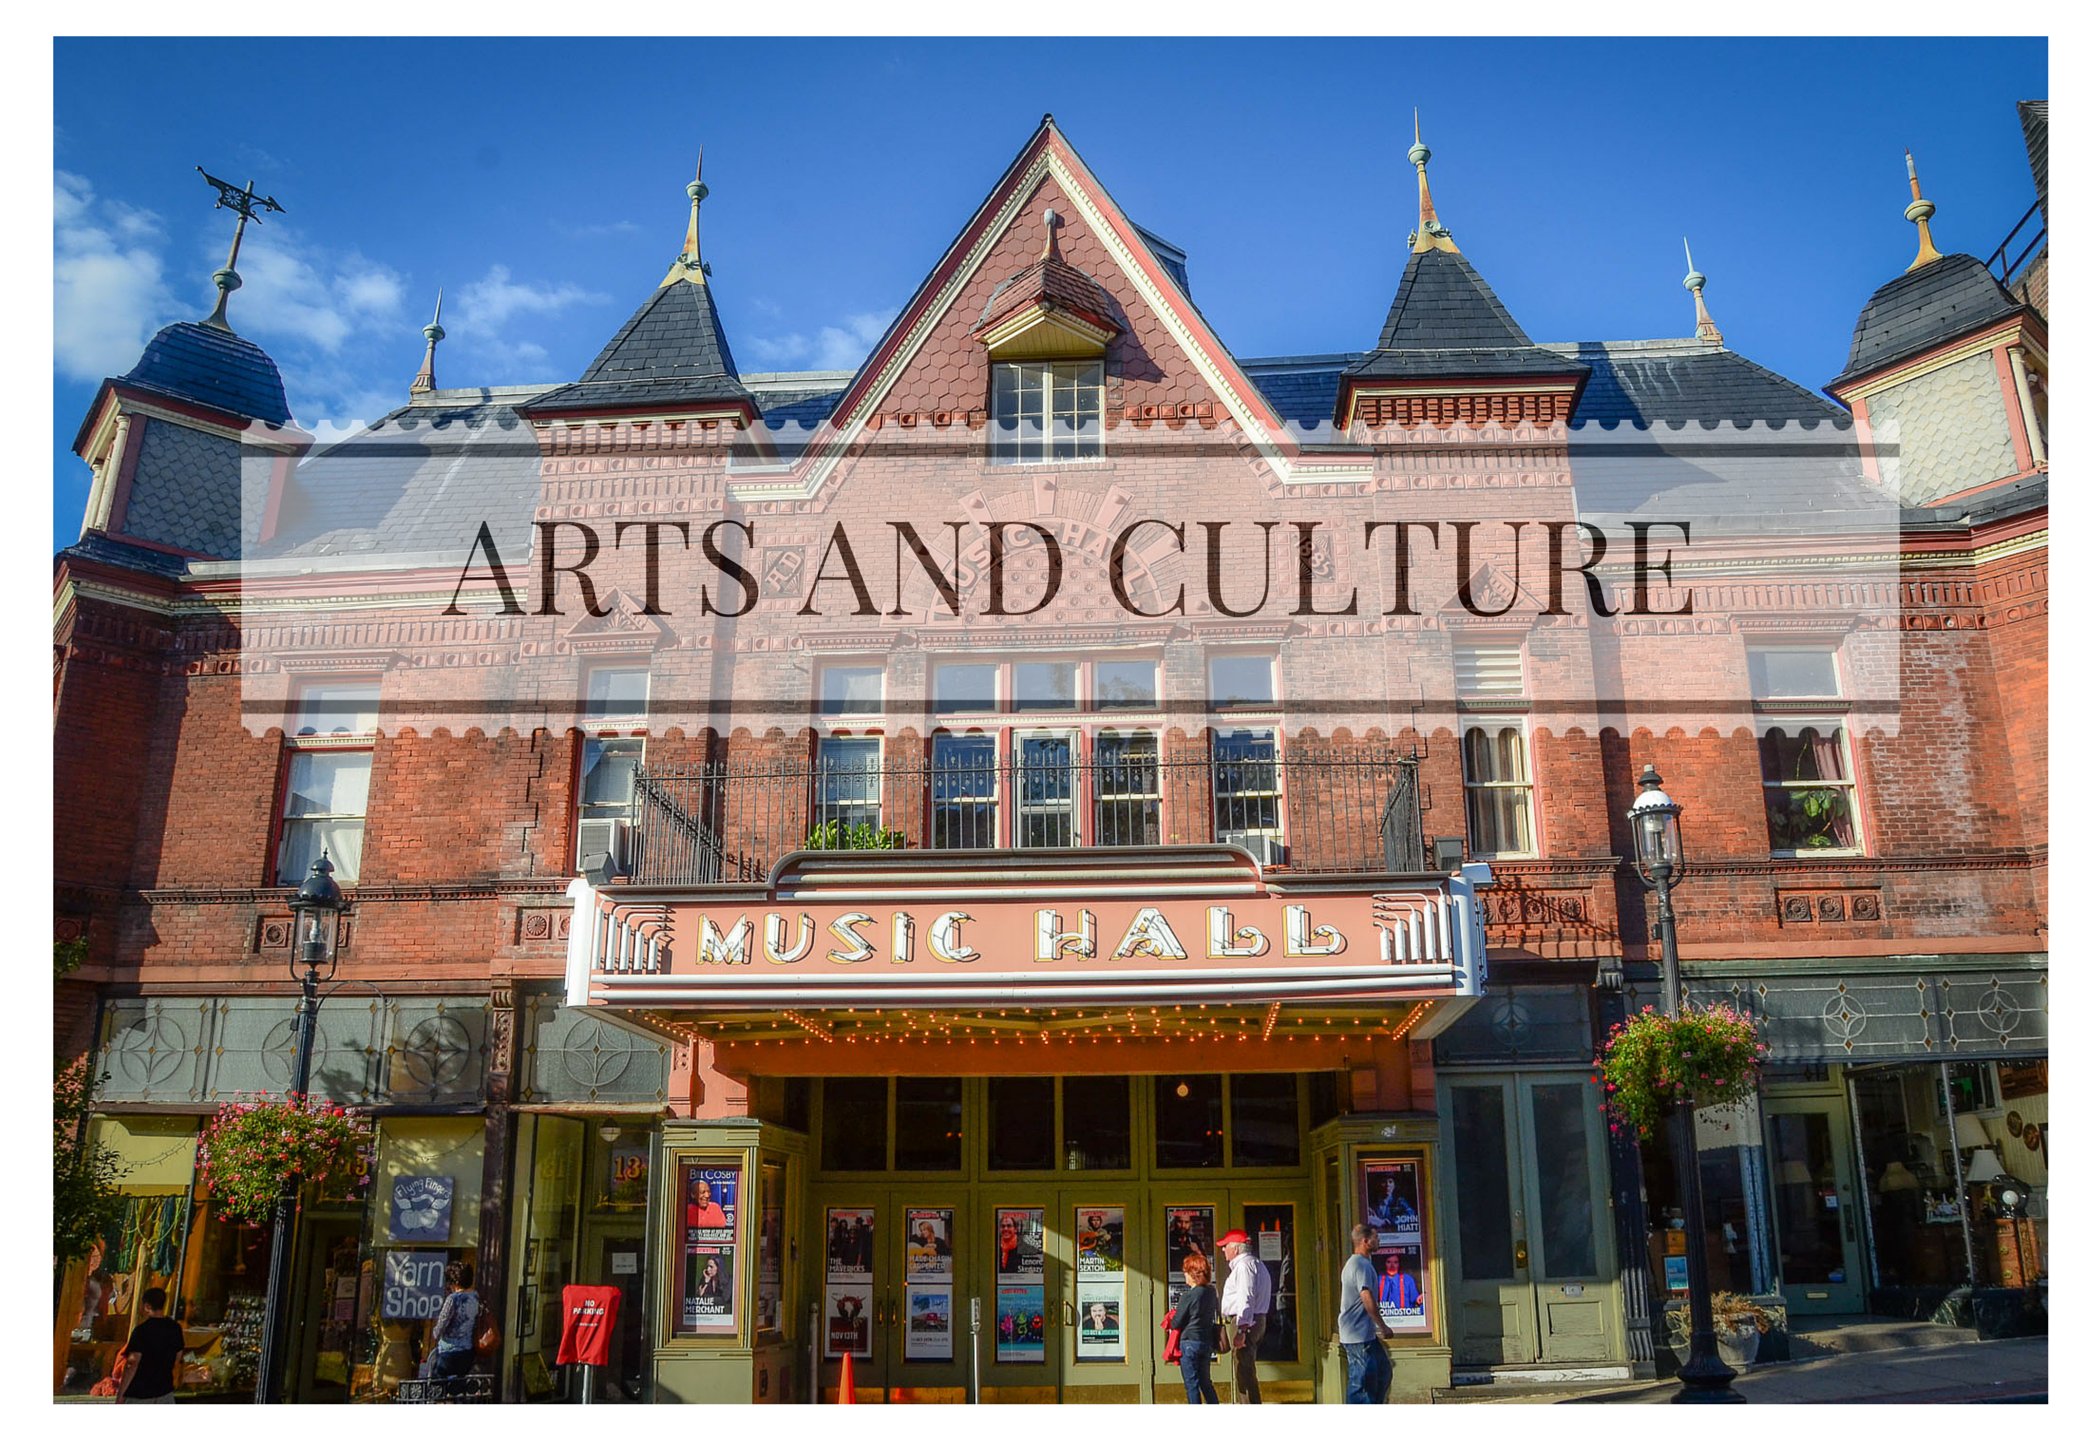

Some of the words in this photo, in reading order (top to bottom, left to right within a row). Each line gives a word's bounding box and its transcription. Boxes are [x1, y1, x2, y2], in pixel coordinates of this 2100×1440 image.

[696, 910, 980, 965] MUSIC
[1033, 904, 1345, 963] HALL
[614, 1155, 641, 1180] 13
[705, 1169, 736, 1180] COSBY
[395, 1179, 424, 1197] Flying
[425, 1177, 450, 1198] Fingers
[388, 1255, 445, 1288] Yarn
[386, 1287, 444, 1319] Shop
[584, 1299, 595, 1307] NO
[685, 1297, 714, 1305] NATALIE
[685, 1305, 725, 1313] MERCHANT
[1379, 1307, 1422, 1316] OUNDSTONE
